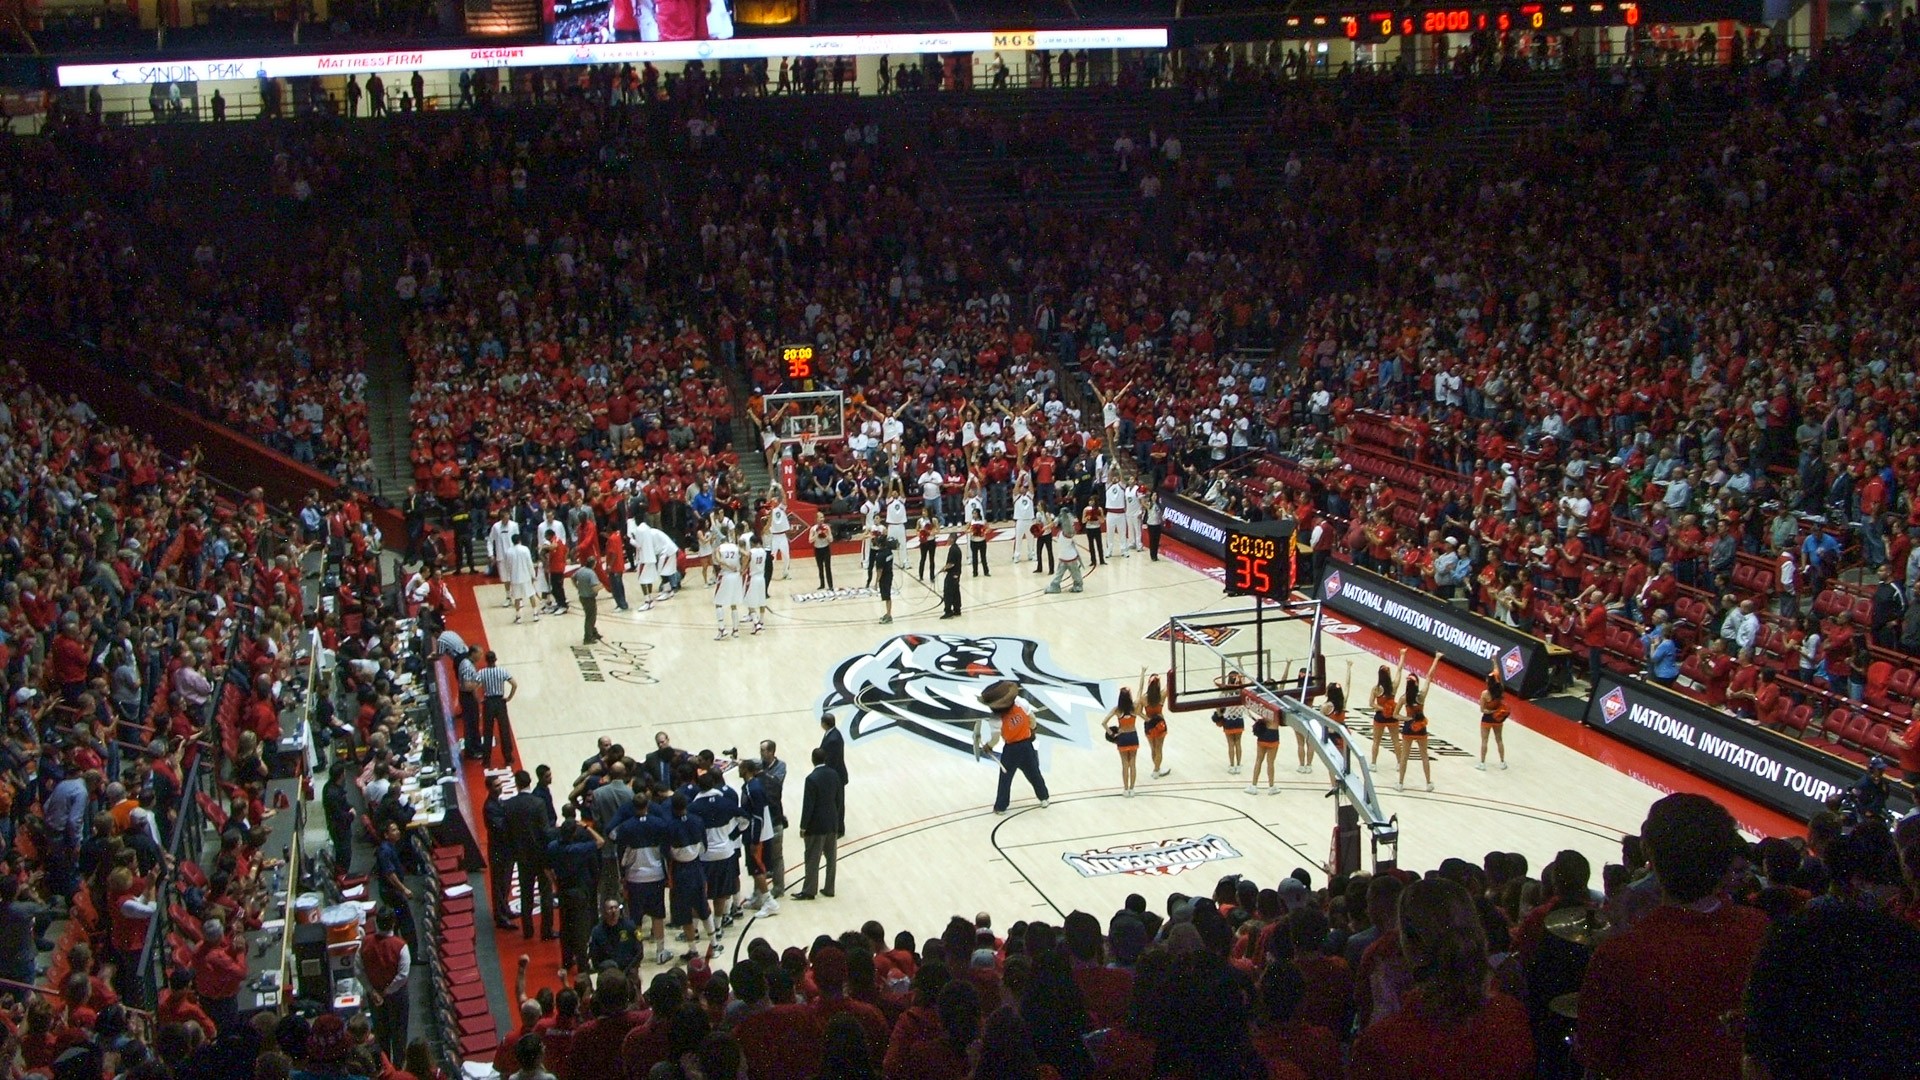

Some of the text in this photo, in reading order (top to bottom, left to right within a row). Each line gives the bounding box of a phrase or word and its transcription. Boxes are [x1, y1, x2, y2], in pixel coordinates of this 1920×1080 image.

[1382, 19, 1392, 35] 0
[1533, 12, 1543, 28] 0
[139, 63, 245, 83] SANDIA PEAK
[783, 347, 813, 360] 20:00
[788, 360, 811, 378] 35
[1163, 506, 1191, 529] NATIONAL
[1190, 518, 1224, 542] INVITATION
[1229, 534, 1275, 559] 20:00
[1236, 555, 1270, 592] 35
[1341, 582, 1383, 616] NATIONAL
[1383, 601, 1430, 634] INVITATION
[1432, 620, 1500, 660] TOURNAMENT
[1628, 703, 1695, 747] NATIONAL
[1698, 732, 1783, 782] INVITATION
[1070, 838, 1234, 875] MOUNTAIN
